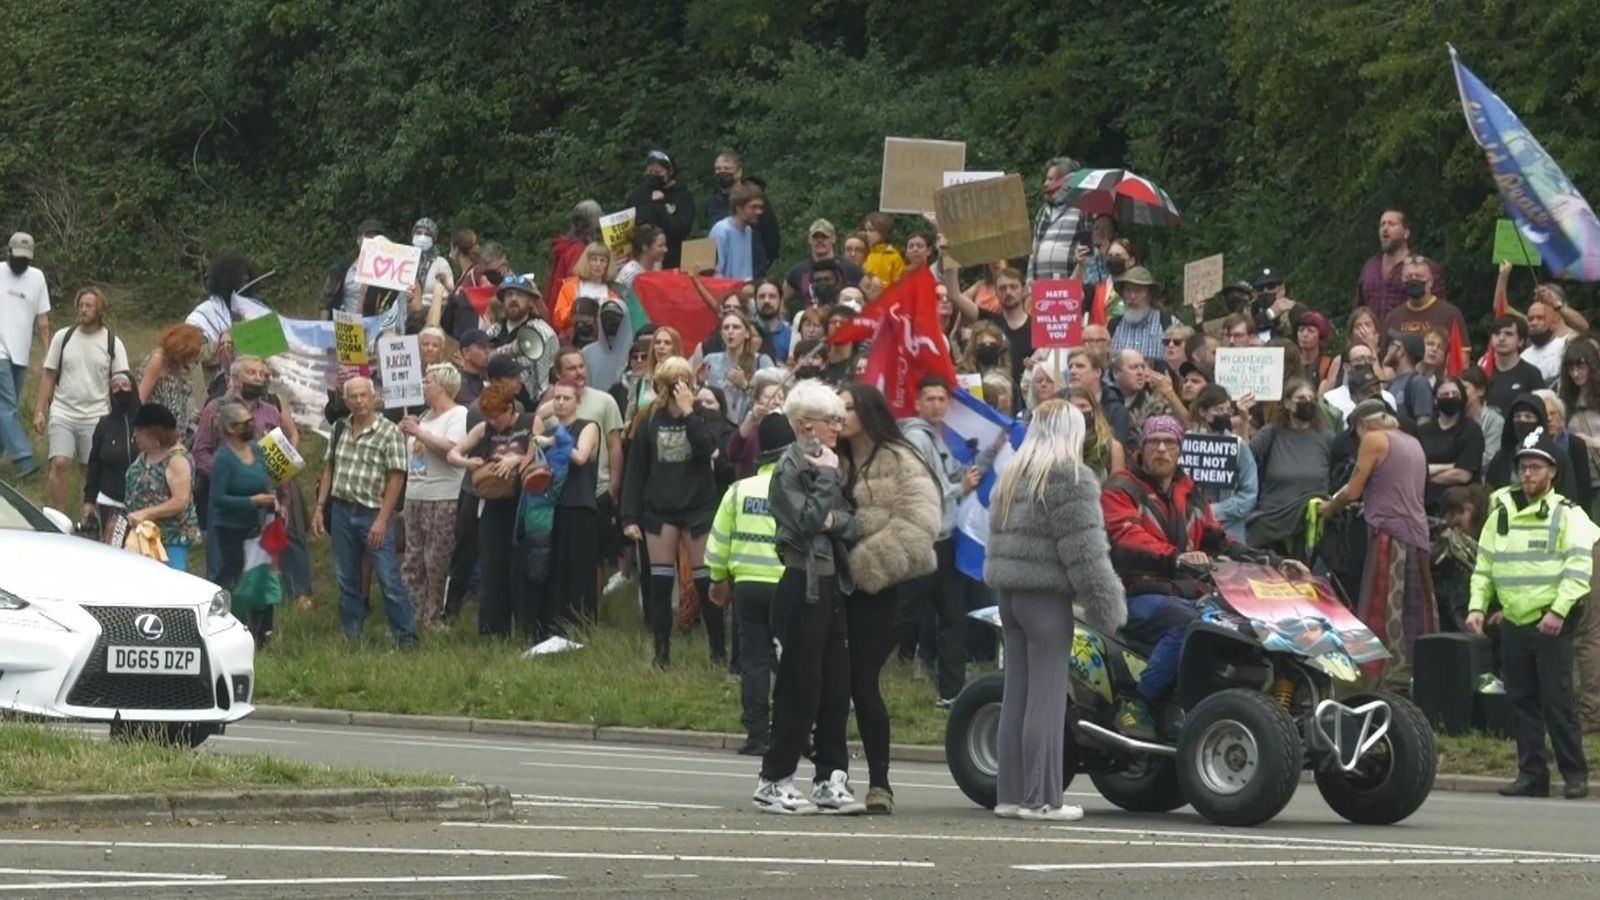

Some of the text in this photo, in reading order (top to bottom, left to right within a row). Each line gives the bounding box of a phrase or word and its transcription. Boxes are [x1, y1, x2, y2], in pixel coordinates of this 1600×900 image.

[1046, 290, 1069, 298] HATE
[1037, 314, 1078, 323] WILL NOT
[1047, 323, 1069, 331] SAVE
[1049, 331, 1067, 339] YOU
[269, 443, 290, 465] STOP
[1182, 439, 1238, 456] MIGRANTS
[1177, 455, 1228, 468] ARE NOT
[1193, 468, 1235, 484] ENEMY
[744, 498, 769, 513] POL
[115, 649, 195, 670] DG65 DZP
